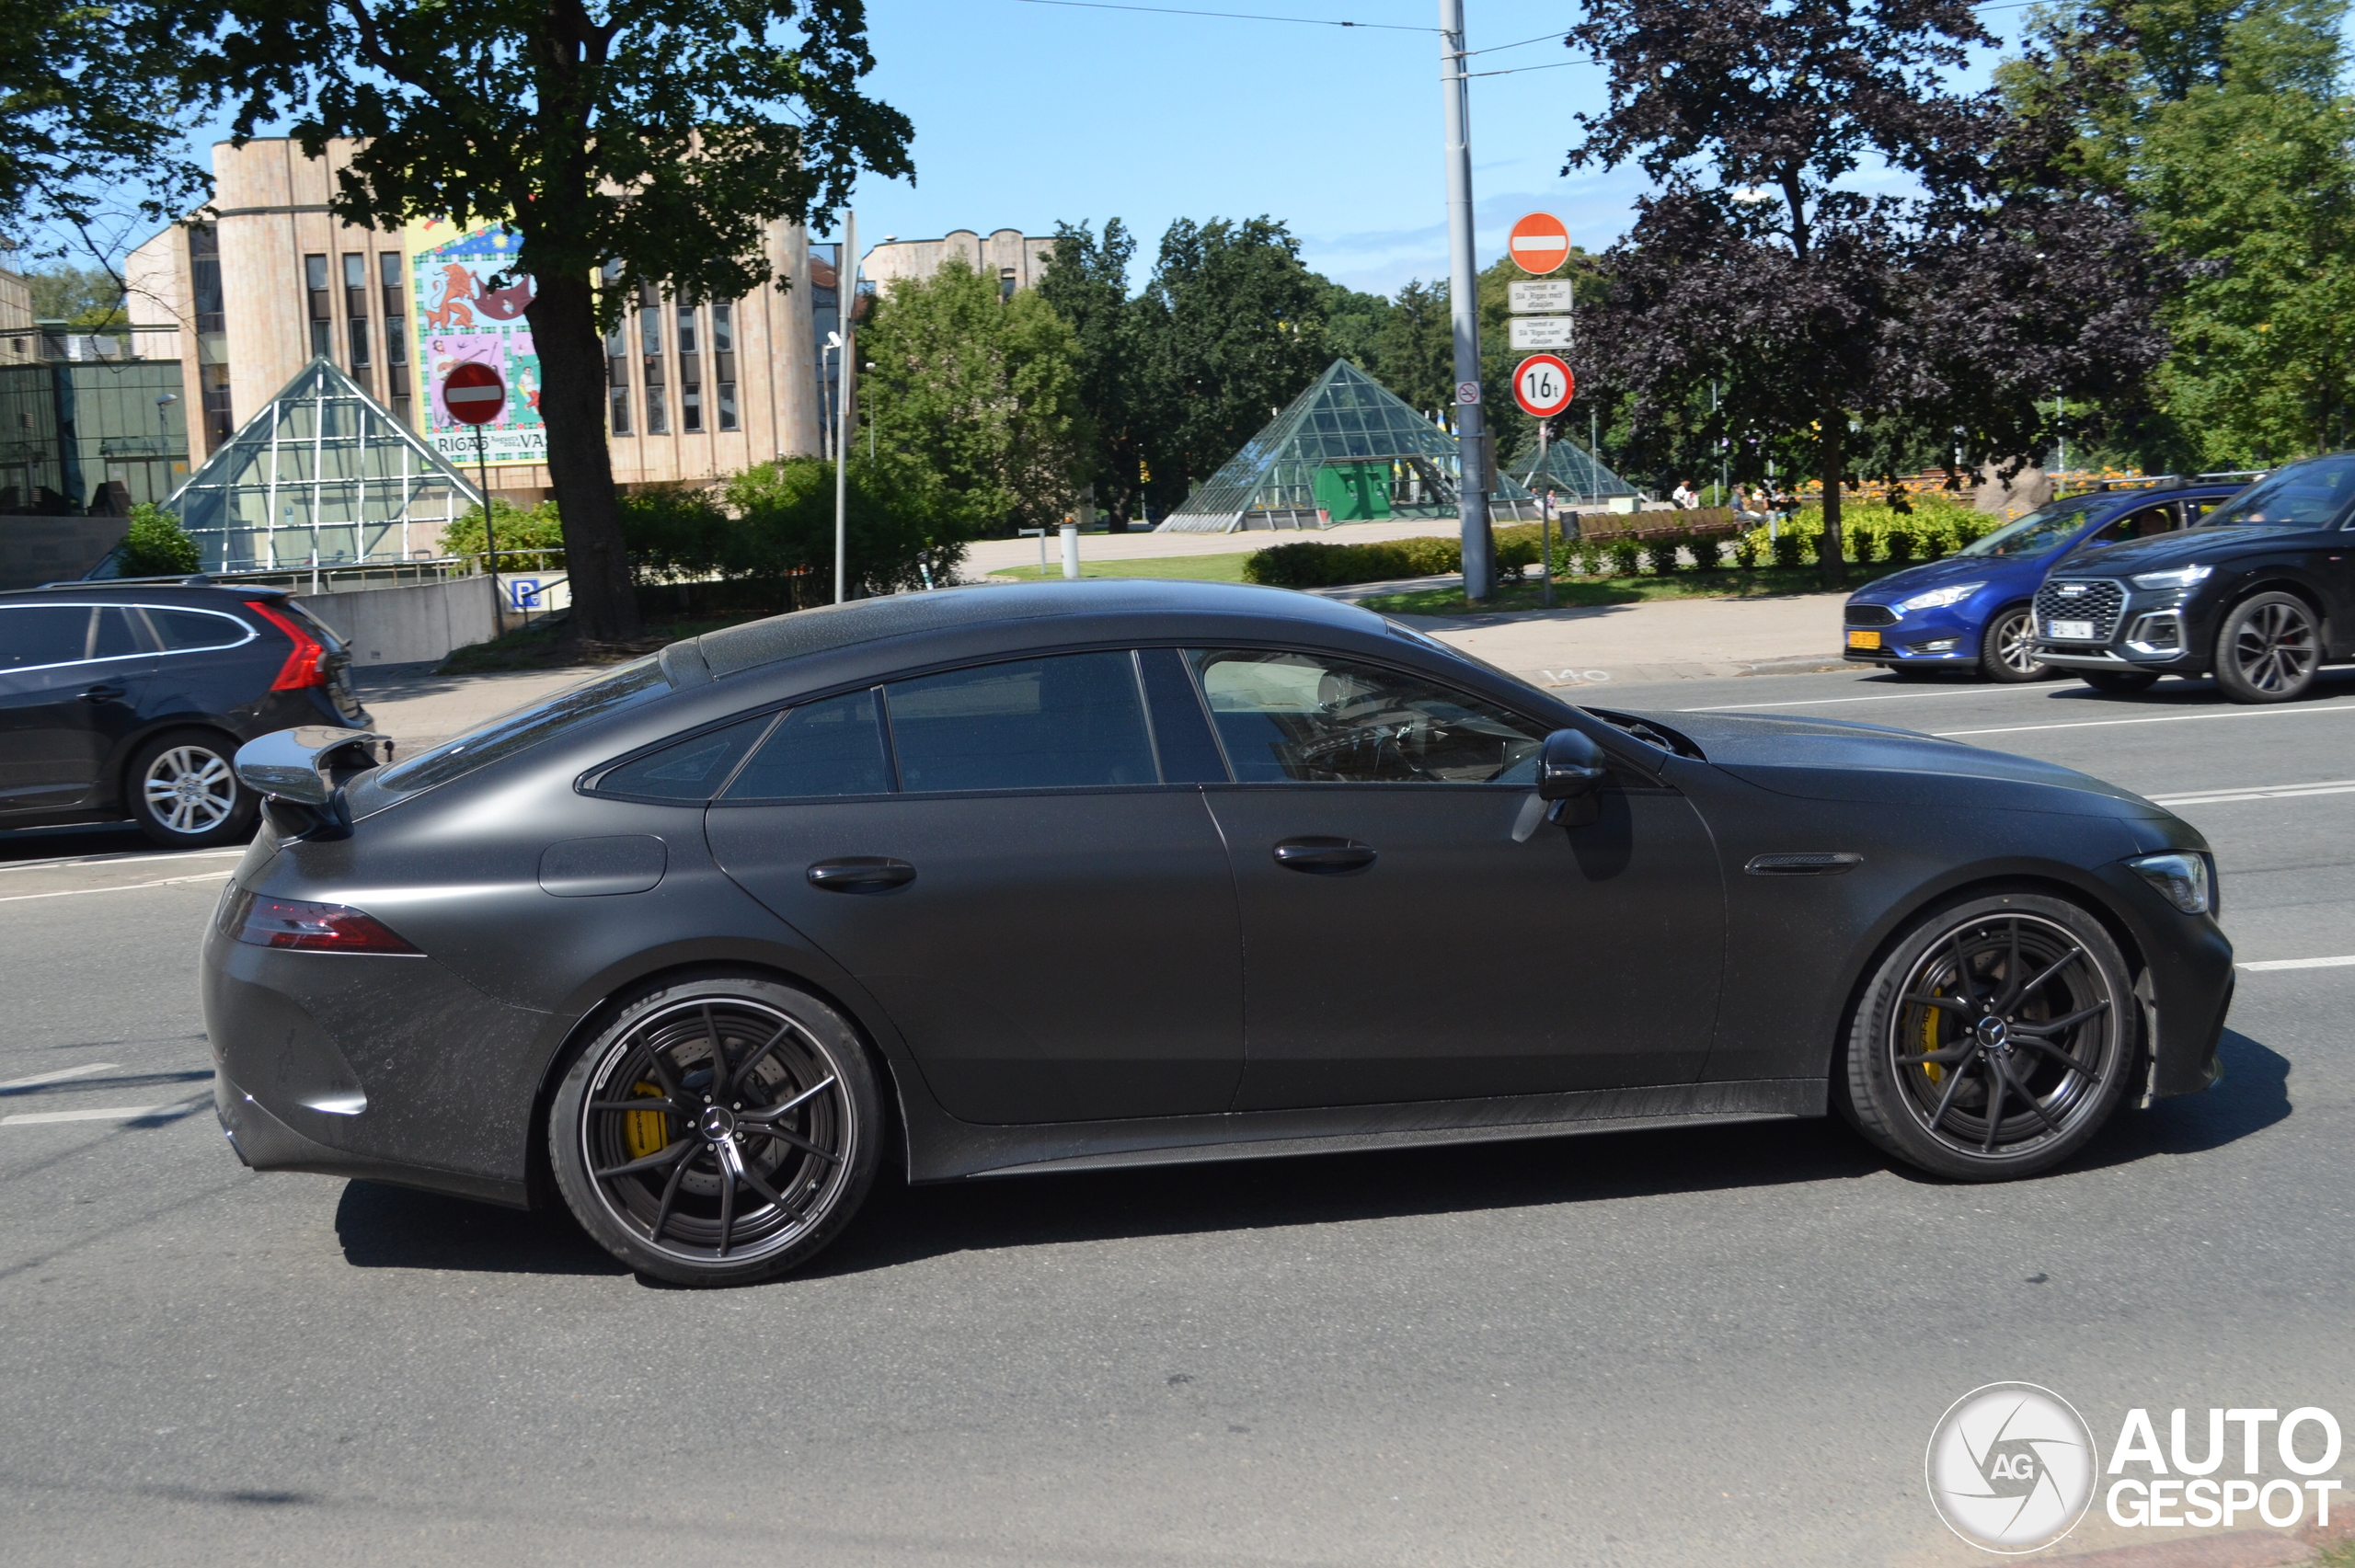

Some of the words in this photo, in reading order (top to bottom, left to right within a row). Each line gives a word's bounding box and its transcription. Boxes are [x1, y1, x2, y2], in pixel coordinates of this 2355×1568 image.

[1527, 372, 1551, 398] 16
[1554, 385, 1559, 397] t
[520, 434, 545, 448] VA
[516, 581, 534, 605] P
[1542, 669, 1611, 685] 140
